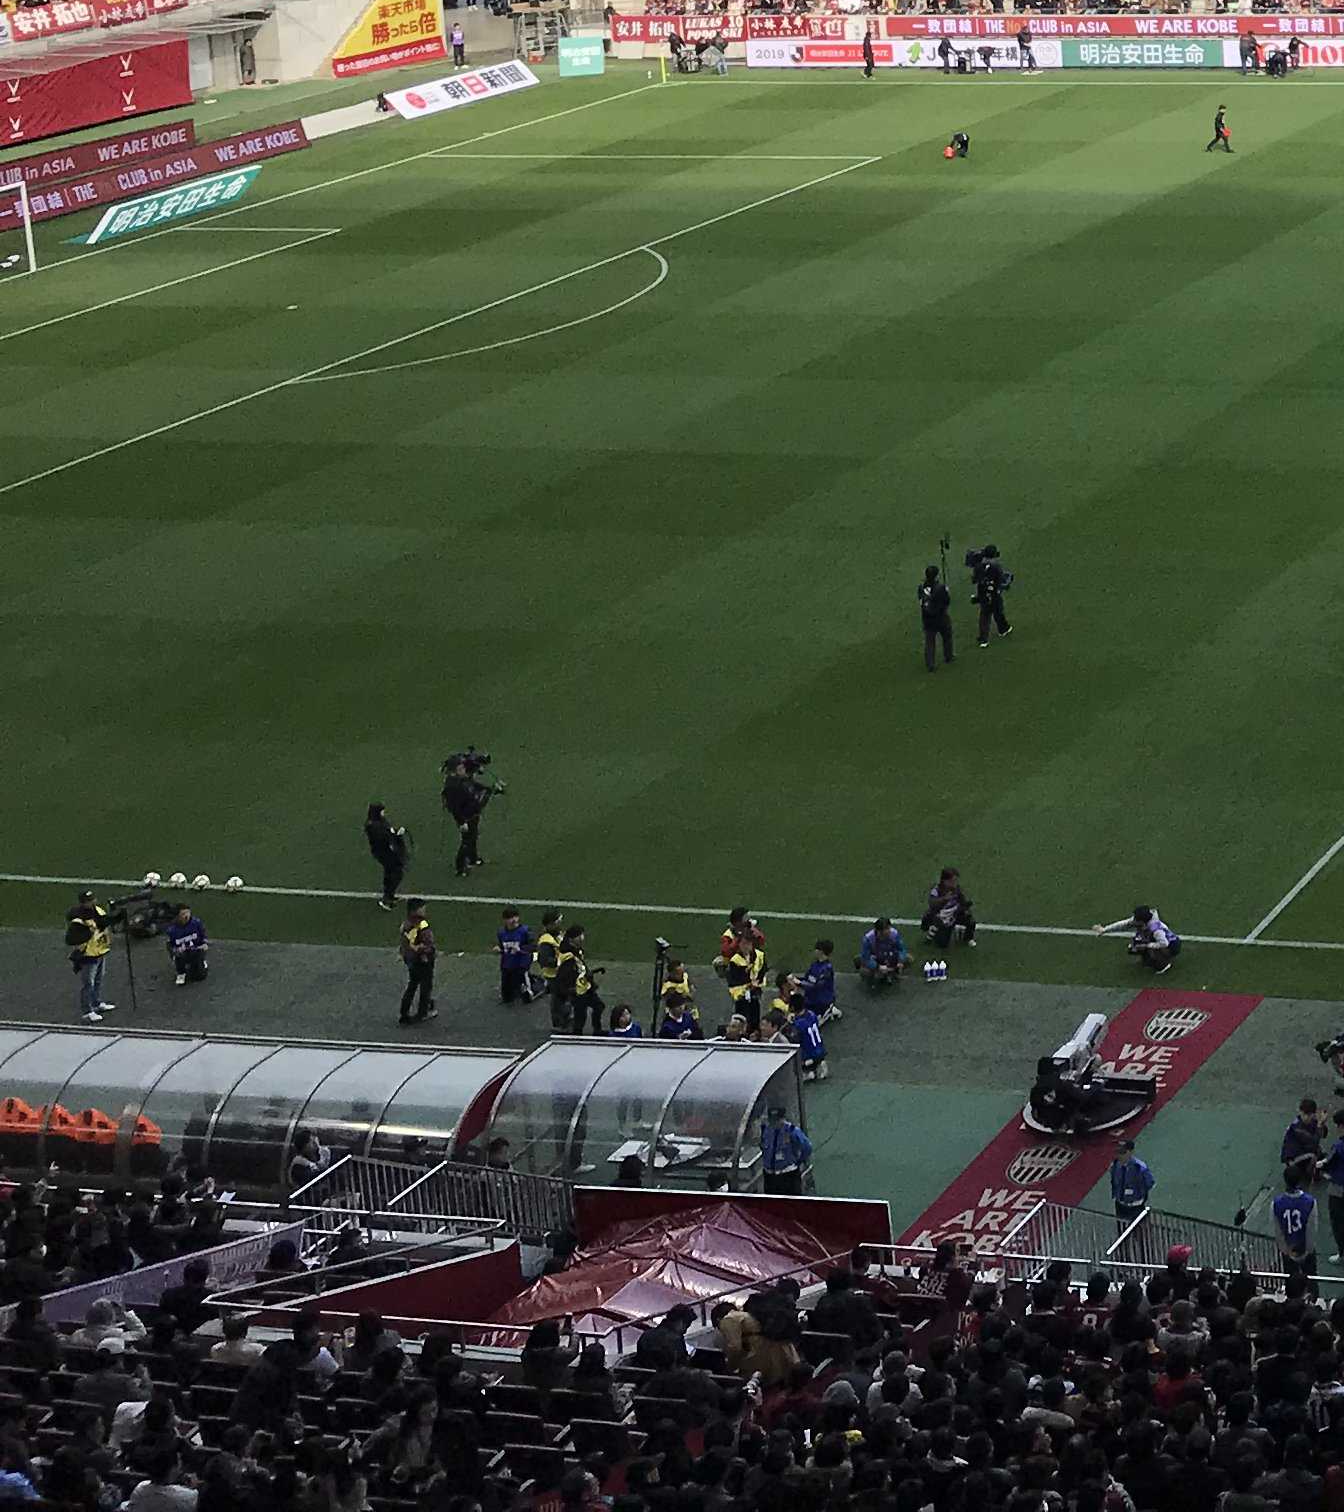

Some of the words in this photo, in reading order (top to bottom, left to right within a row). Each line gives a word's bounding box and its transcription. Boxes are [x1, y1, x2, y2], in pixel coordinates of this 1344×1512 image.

[372, 12, 437, 45] 勝ったら倍
[686, 28, 743, 40] PODOSKI
[984, 19, 1005, 34] THE
[1029, 19, 1057, 34] CLUB
[1061, 19, 1073, 34] in
[1077, 19, 1111, 34] ASIA
[1136, 19, 1158, 34] WE
[1160, 19, 1193, 34] ARE
[1197, 19, 1238, 34] KOBE
[754, 48, 786, 59] 2019
[1079, 43, 1205, 64] 明治安田生命
[441, 64, 528, 101] 朝日新聞
[98, 143, 120, 162] WE
[121, 136, 149, 156] ARE
[151, 128, 187, 149] KOBE
[214, 145, 237, 163] WE
[238, 138, 265, 158] ARE
[267, 128, 300, 149] KOBE
[25, 165, 38, 180] in
[41, 155, 76, 176] ASIA
[73, 183, 97, 203] THE
[117, 172, 146, 191] CLUB
[149, 167, 162, 183] in
[165, 157, 198, 178] ASIA
[110, 175, 247, 234] 明治安田生命
[1119, 1043, 1180, 1062] WE
[977, 1188, 1046, 1210] WE
[1283, 1209, 1302, 1235] 13
